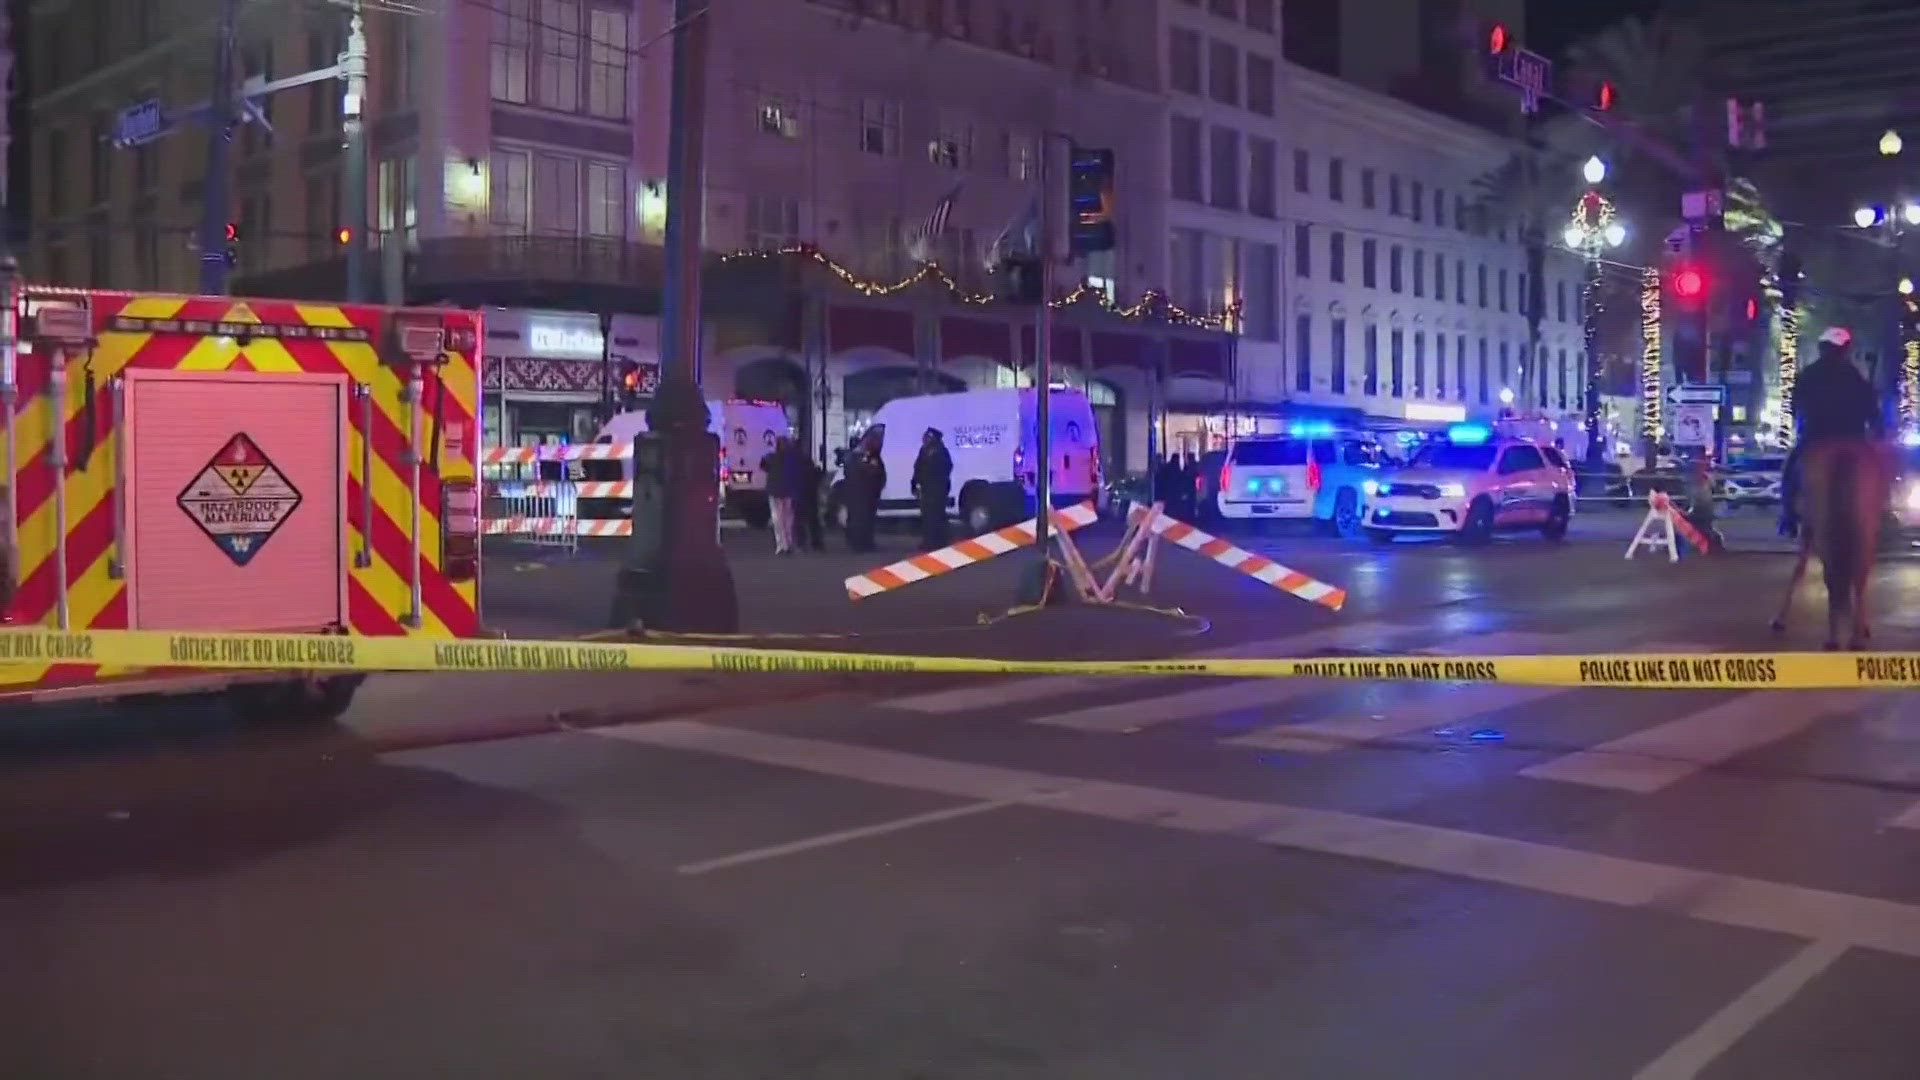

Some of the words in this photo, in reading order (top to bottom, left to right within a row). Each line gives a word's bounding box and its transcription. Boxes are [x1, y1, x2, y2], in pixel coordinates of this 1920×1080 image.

[1444, 661, 1497, 681] CROSS
[1580, 660, 1631, 682] POLICE
[1634, 660, 1665, 683] LINE
[1669, 660, 1690, 683] DO
[1693, 659, 1722, 682] NOT
[1726, 658, 1777, 682] CROSS
[1857, 658, 1907, 681] POLICE
